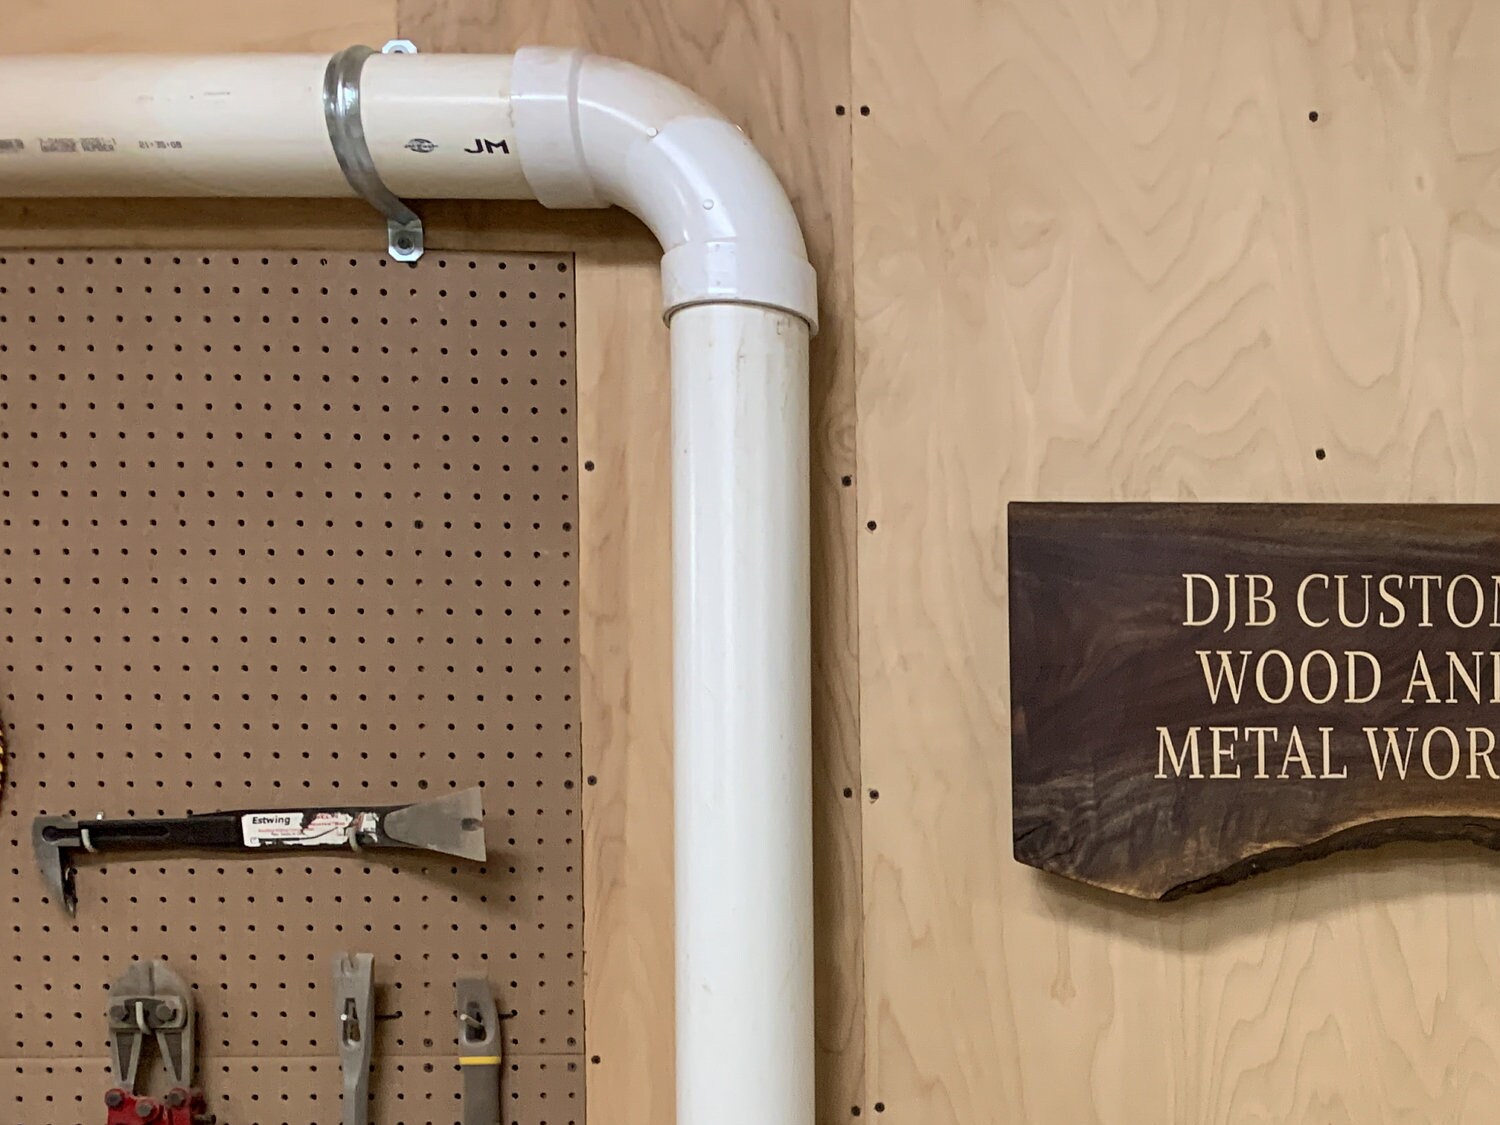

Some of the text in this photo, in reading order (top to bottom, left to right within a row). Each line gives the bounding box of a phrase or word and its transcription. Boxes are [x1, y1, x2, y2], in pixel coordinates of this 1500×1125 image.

[464, 139, 510, 154] JM
[1182, 573, 1276, 632] DJB
[1196, 650, 1381, 704] WOOD
[1154, 726, 1347, 779] METAL
[252, 816, 291, 825] Estwing
